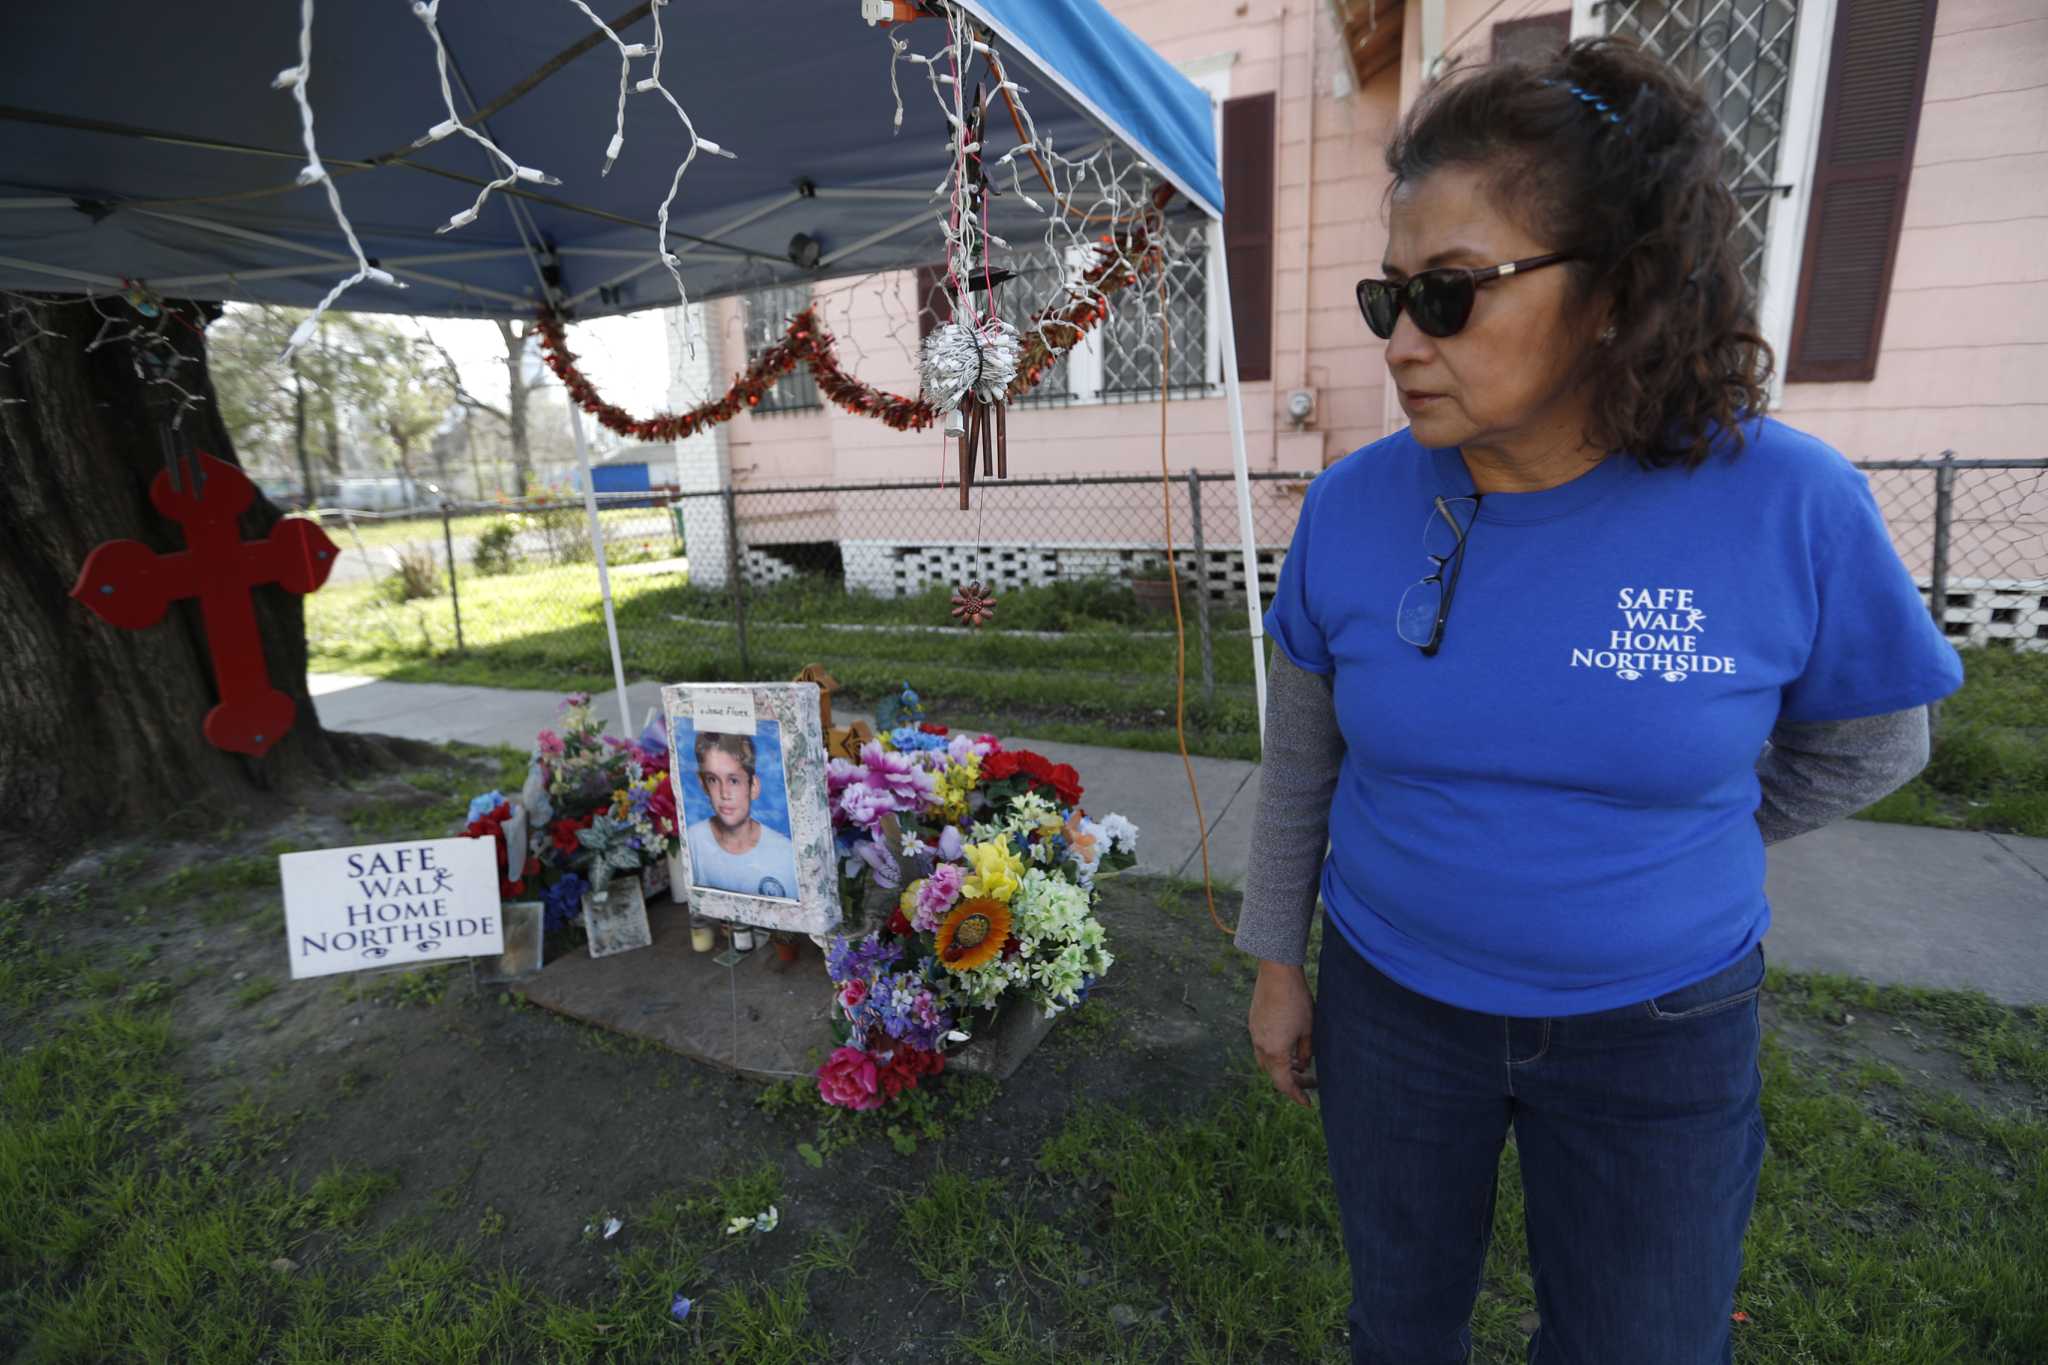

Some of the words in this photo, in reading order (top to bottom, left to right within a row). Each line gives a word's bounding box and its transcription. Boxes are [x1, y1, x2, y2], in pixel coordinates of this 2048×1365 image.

[1617, 587, 1695, 611] SAFE
[1624, 608, 1706, 633] WALK
[1609, 630, 1697, 653] HOME
[1570, 648, 1737, 674] NORTHSIDE
[347, 847, 437, 879] SAFE
[360, 867, 453, 900] WALK
[347, 898, 449, 927] HOME
[301, 916, 495, 956] NORTHSIDE
